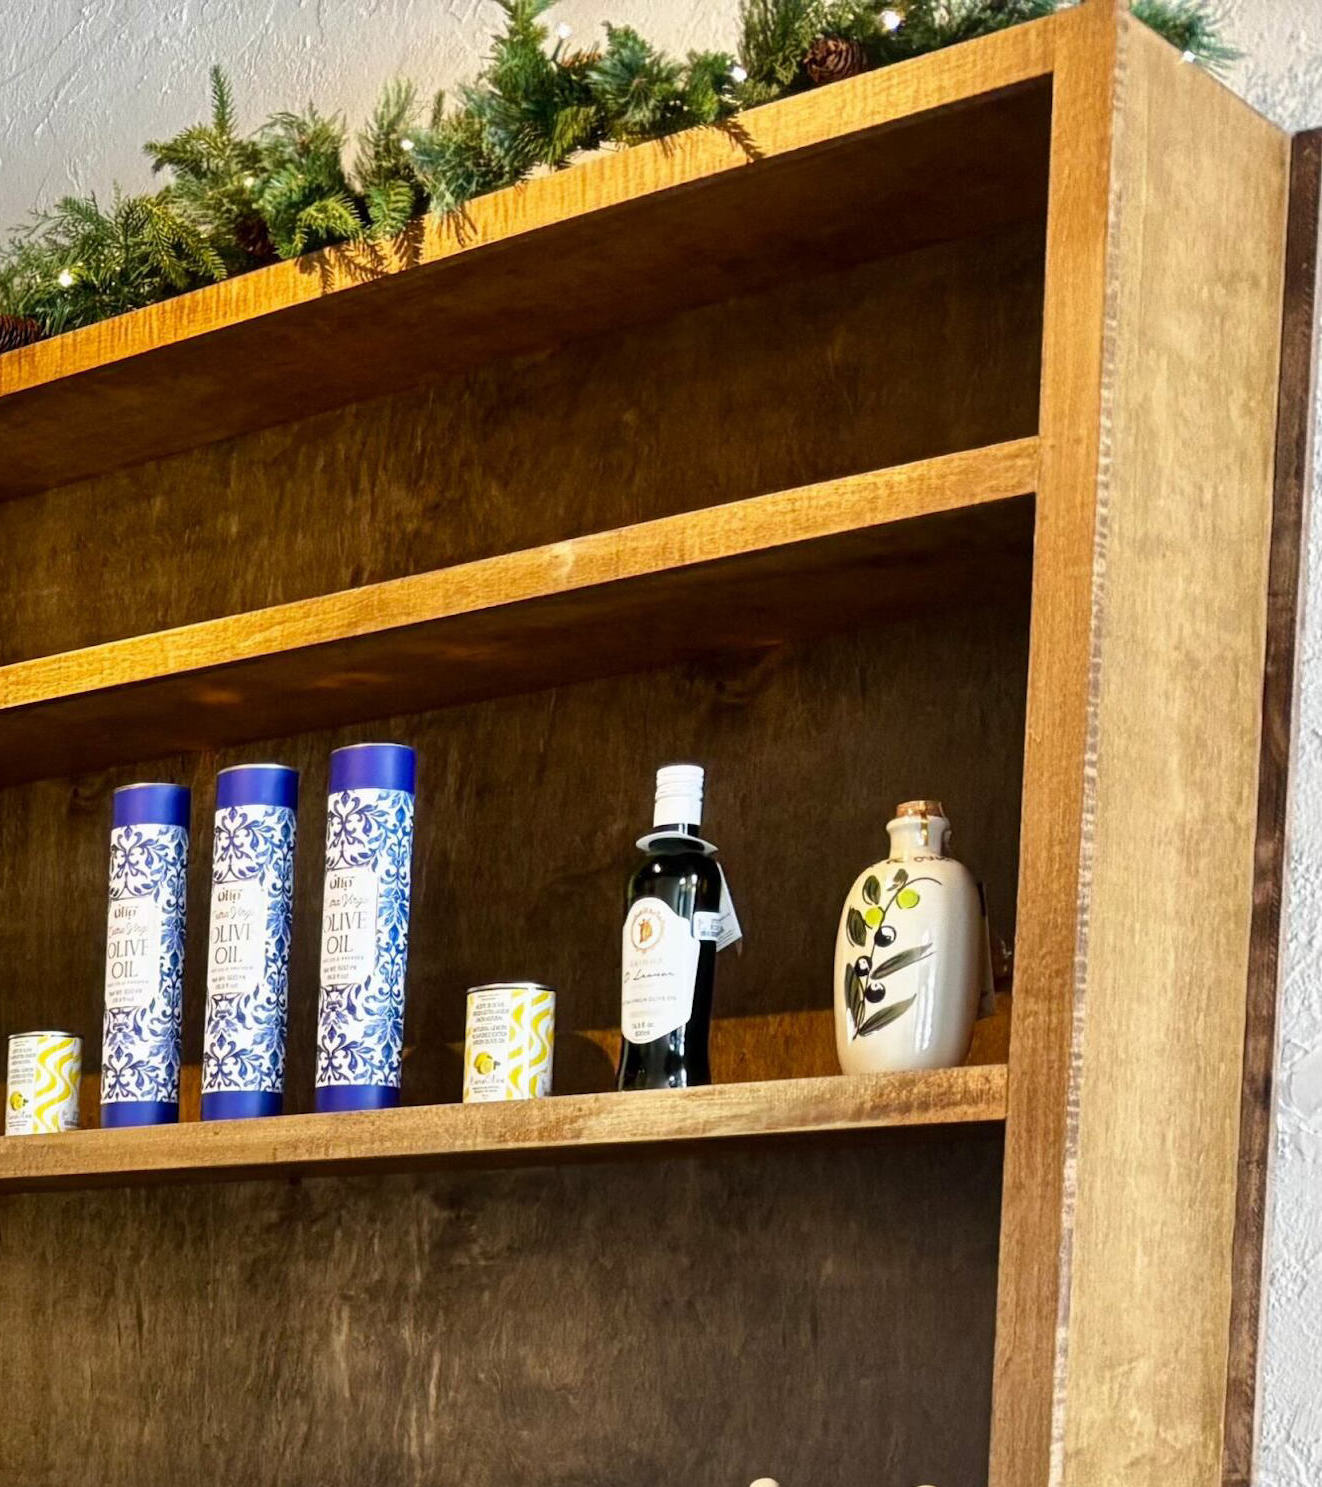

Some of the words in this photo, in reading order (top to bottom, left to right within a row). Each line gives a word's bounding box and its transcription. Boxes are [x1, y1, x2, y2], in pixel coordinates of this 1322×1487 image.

[324, 911, 367, 933] OLIVE
[326, 935, 354, 955] OIL
[214, 946, 243, 965] OIL
[111, 960, 138, 980] OIL
